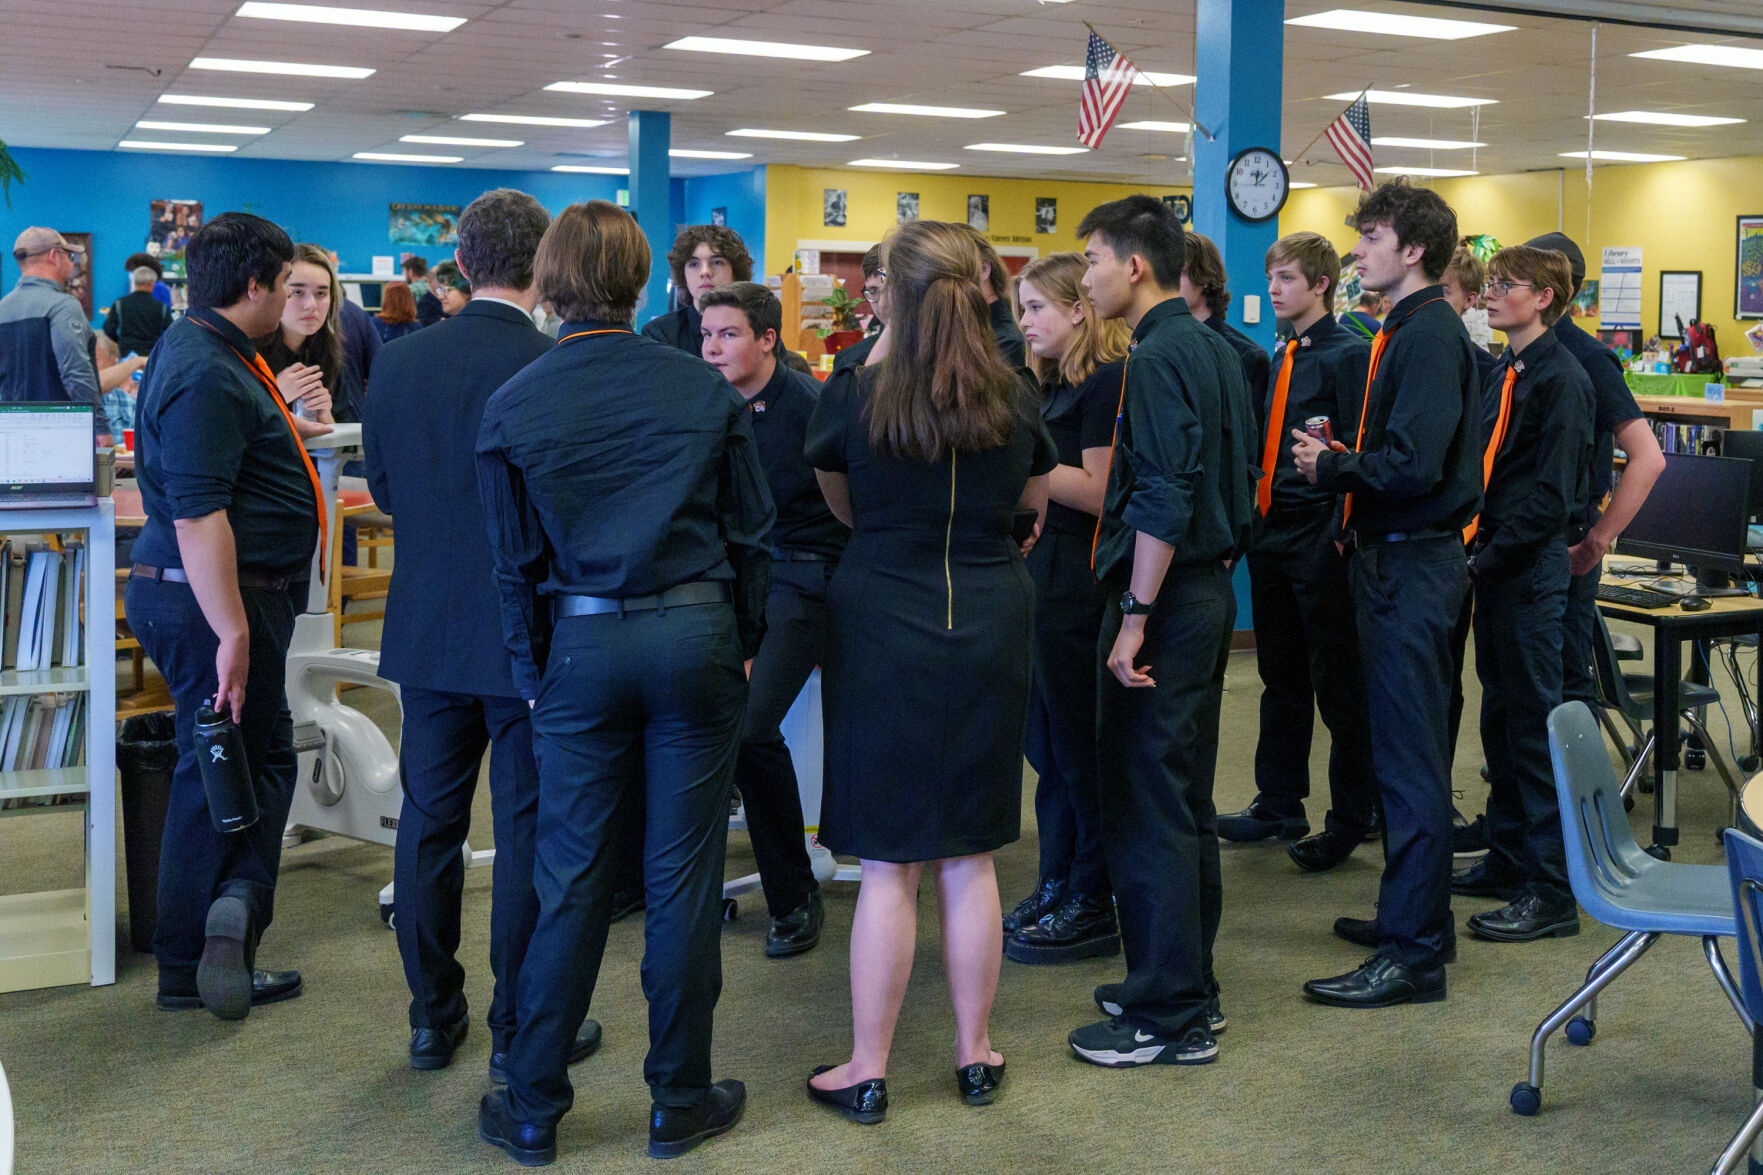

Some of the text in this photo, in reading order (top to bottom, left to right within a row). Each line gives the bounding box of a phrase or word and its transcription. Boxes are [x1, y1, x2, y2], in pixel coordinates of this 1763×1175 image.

[1244, 159, 1250, 167] 11
[1266, 160, 1269, 168] 1
[1275, 182, 1279, 190] 3
[1235, 192, 1240, 200] 8
[1252, 205, 1257, 213] 6
[1603, 249, 1628, 258] Library
